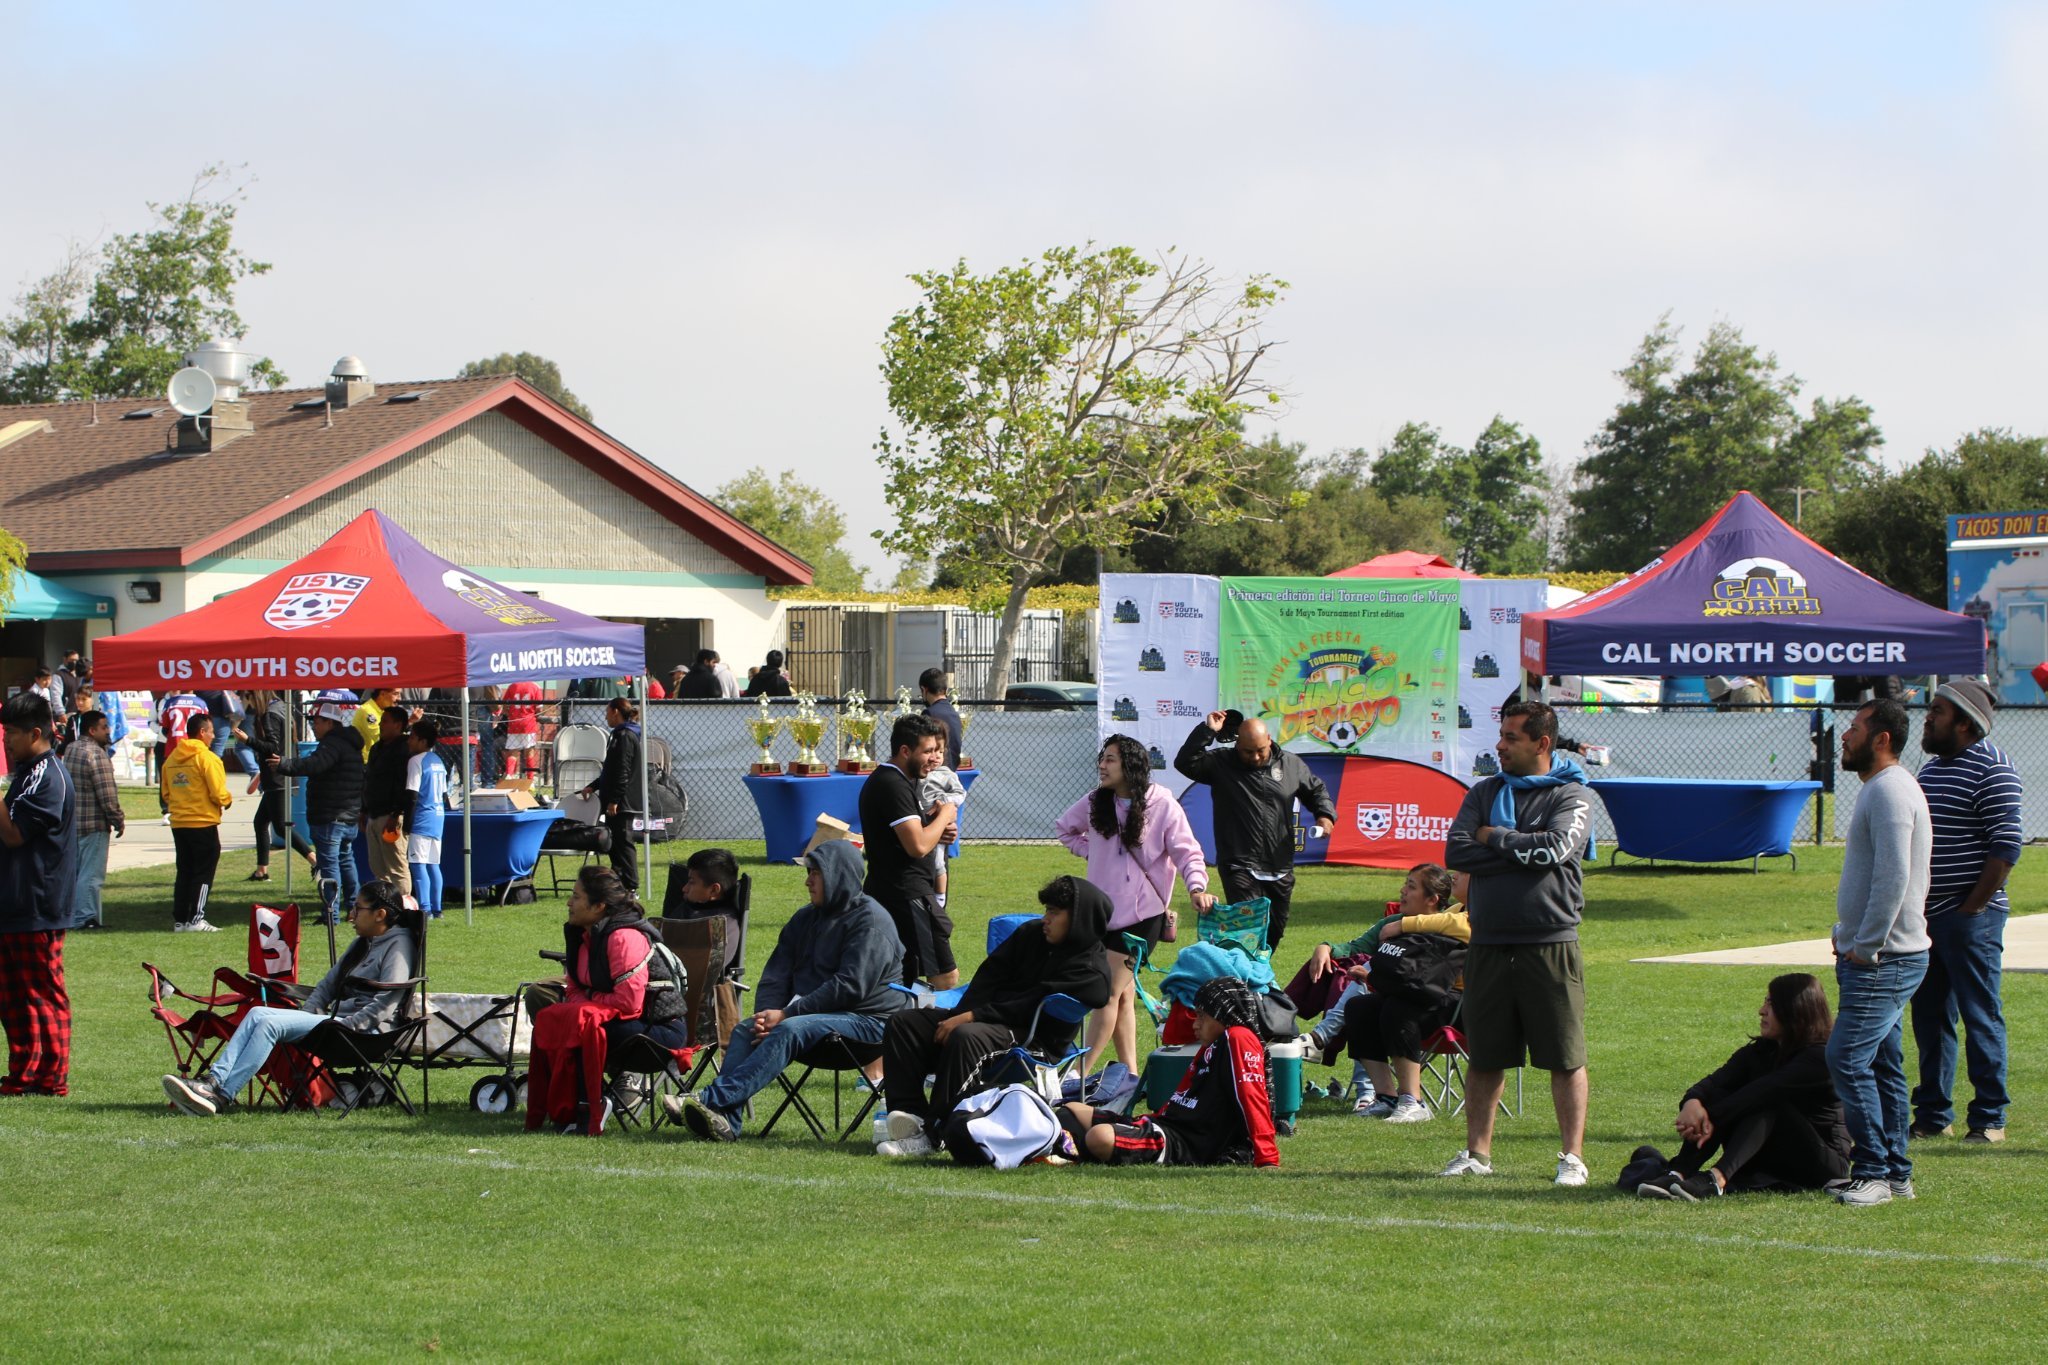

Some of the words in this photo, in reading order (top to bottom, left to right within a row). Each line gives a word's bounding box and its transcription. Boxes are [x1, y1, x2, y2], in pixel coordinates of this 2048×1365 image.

[1957, 518, 2000, 537] TACOS
[2003, 516, 2033, 535] DON
[289, 575, 364, 589] USYS
[1713, 577, 1807, 600] CAL
[1227, 588, 1273, 601] Primera
[1276, 588, 1315, 601] edición
[1319, 588, 1334, 601] del
[1338, 589, 1376, 602] Torneo
[1378, 590, 1409, 602] Cinco
[1412, 590, 1425, 602] de
[1428, 590, 1458, 605] Mayo
[1704, 599, 1821, 611] NORTH
[1286, 608, 1293, 617] de
[1295, 608, 1316, 618] Mayo
[1317, 608, 1360, 618] Tournament
[1362, 609, 1379, 618] First
[1381, 609, 1404, 618] edition
[490, 652, 516, 673] CAL
[518, 648, 563, 671] NORTH
[566, 646, 617, 667] SOCCER
[1267, 656, 1291, 687] VIVA
[1290, 640, 1309, 657] LA
[1311, 630, 1361, 646] FIESTA
[1308, 652, 1363, 668] TOURNAMENT
[1602, 642, 1660, 663] CAL
[1670, 642, 1774, 663] NORTH
[1784, 641, 1907, 663] SOCCER
[158, 660, 193, 679] US
[200, 657, 287, 679] YOUTH
[295, 656, 399, 677] SOCCER
[1280, 667, 1396, 715] CINCO
[1279, 709, 1317, 746] DE
[1315, 697, 1401, 731] MAYO
[1395, 803, 1419, 815] US
[1395, 816, 1454, 829] YOUTH
[1395, 828, 1449, 841] SOCCE
[1514, 800, 1589, 865] NAUTICA
[1378, 942, 1406, 957] JORGE
